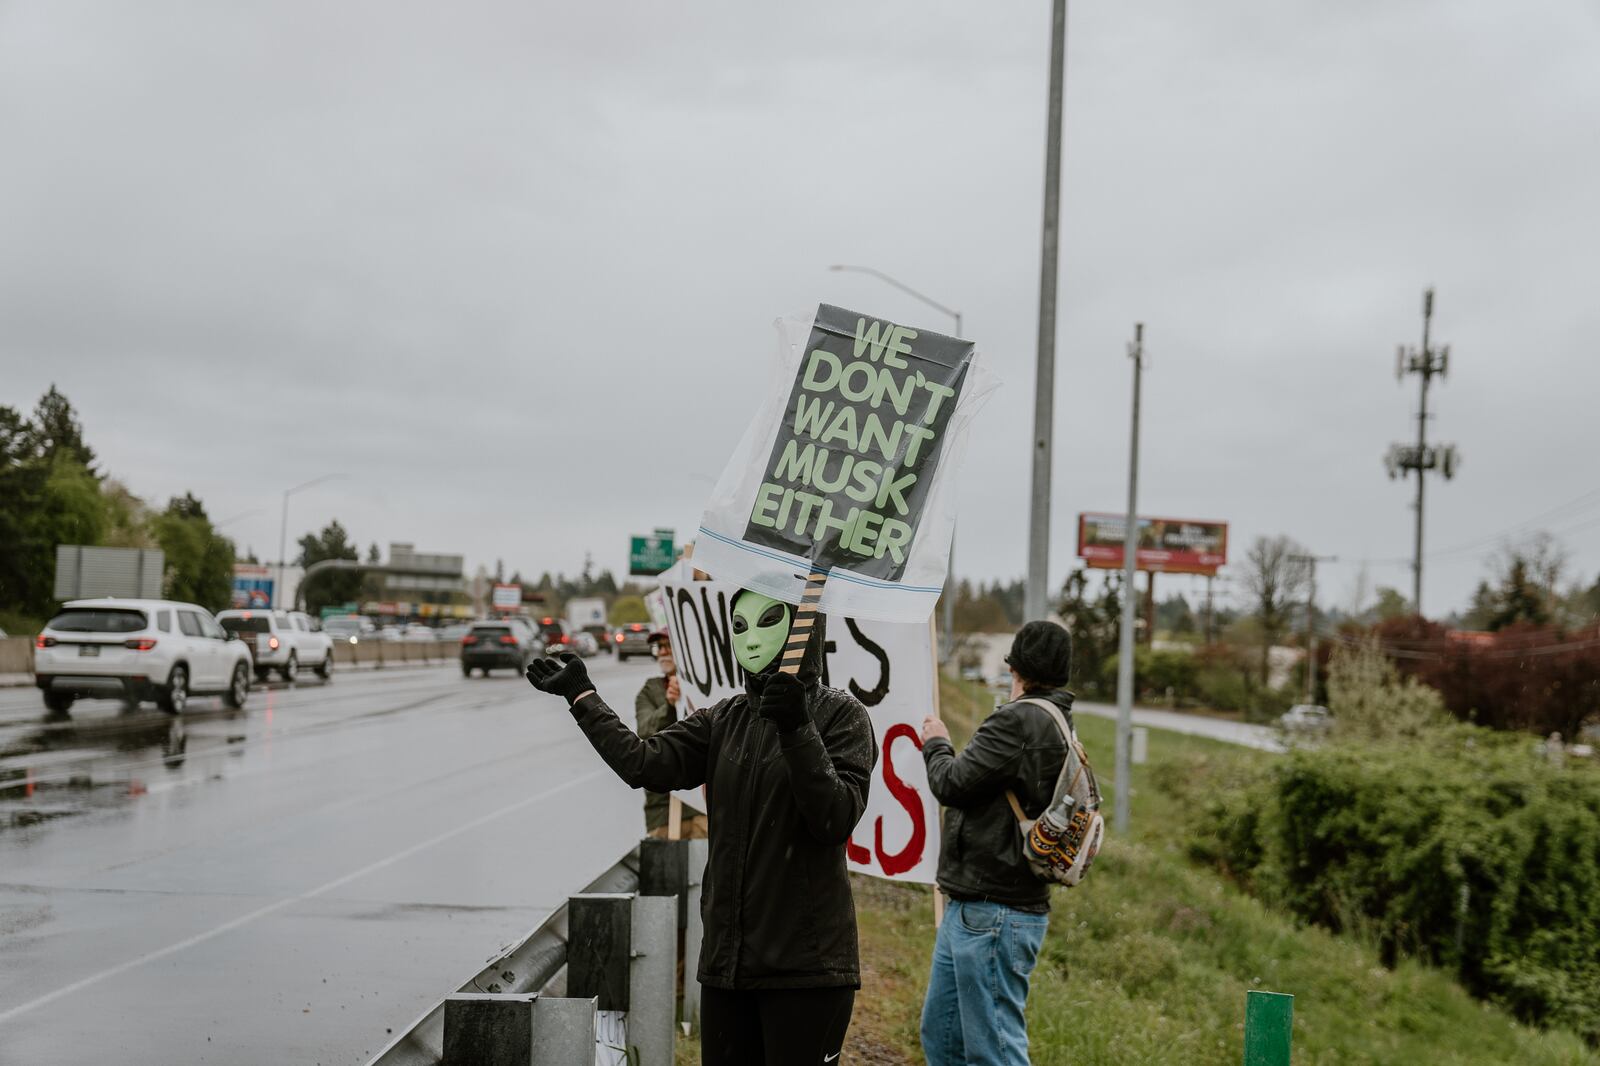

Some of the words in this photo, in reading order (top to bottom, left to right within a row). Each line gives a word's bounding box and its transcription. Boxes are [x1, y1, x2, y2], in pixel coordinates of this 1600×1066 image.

[852, 317, 918, 370] WE
[801, 349, 955, 425] DON'T
[793, 393, 935, 468] WANT
[773, 439, 918, 516] MUSK
[750, 482, 913, 565] EITHER
